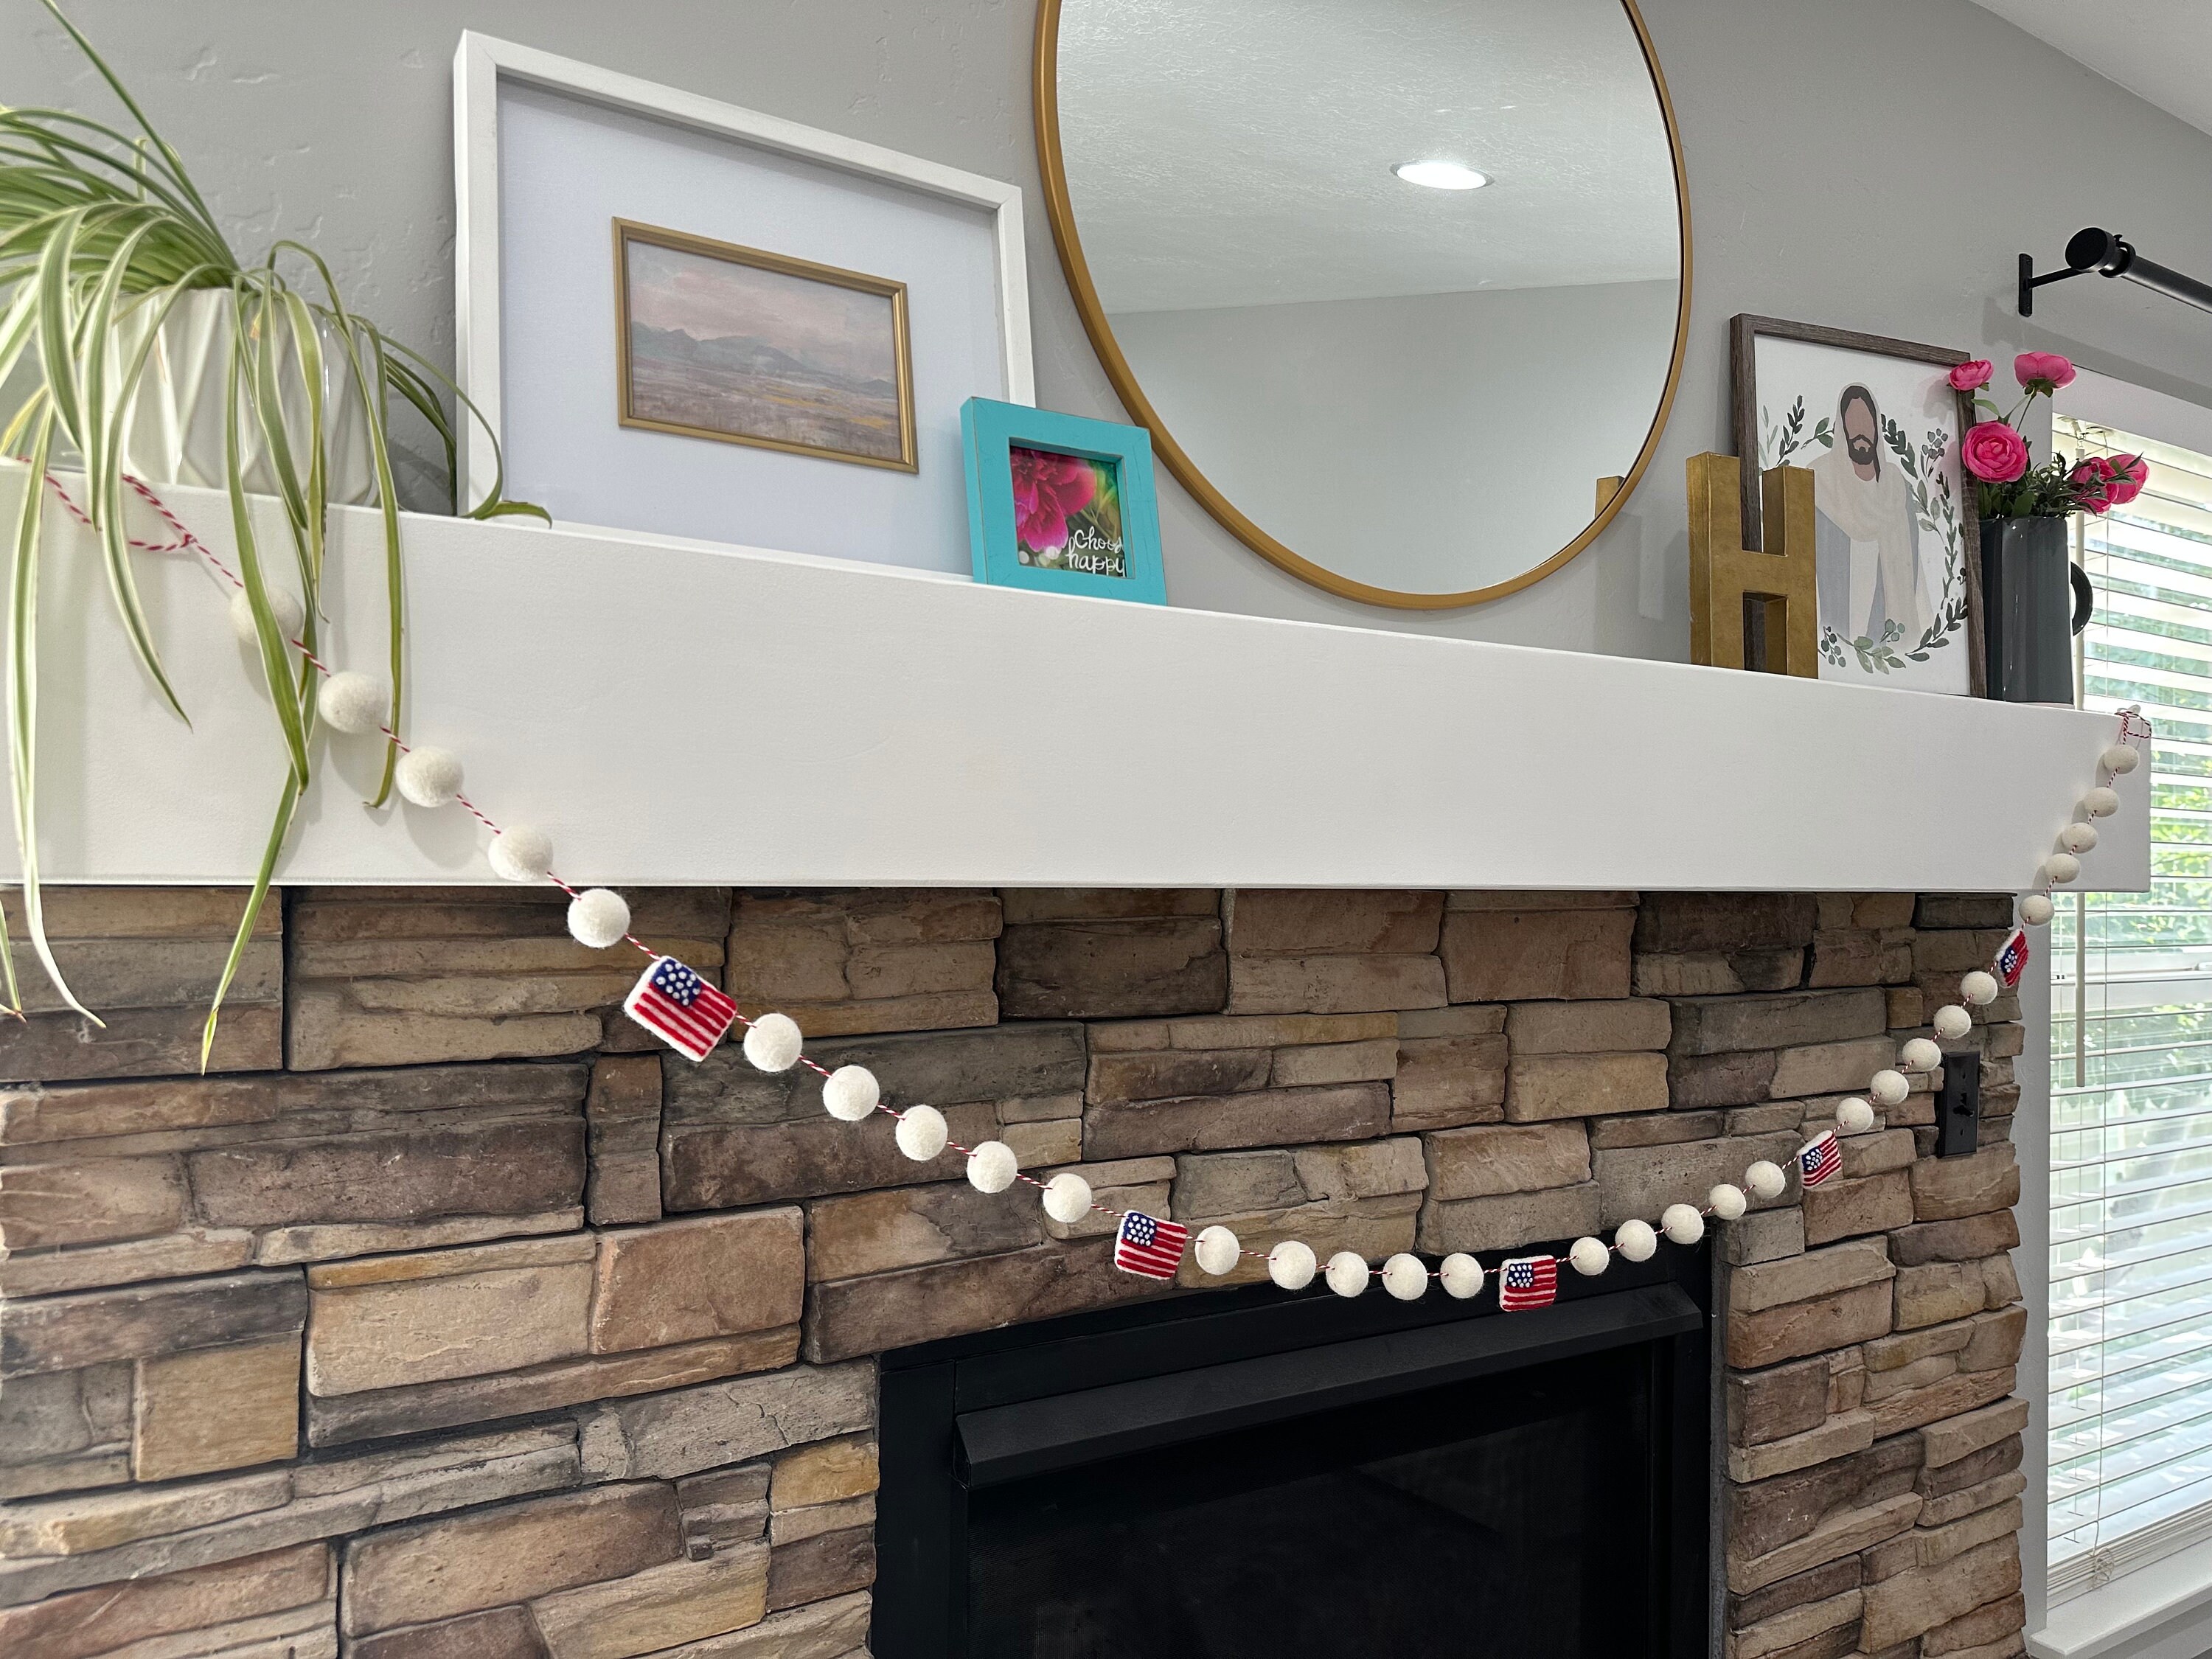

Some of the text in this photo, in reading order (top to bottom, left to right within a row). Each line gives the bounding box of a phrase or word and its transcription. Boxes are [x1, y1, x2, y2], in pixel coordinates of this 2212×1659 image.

[1064, 537, 1126, 578] happy
[1074, 526, 1124, 554] Choos
[1686, 451, 1819, 680] H
